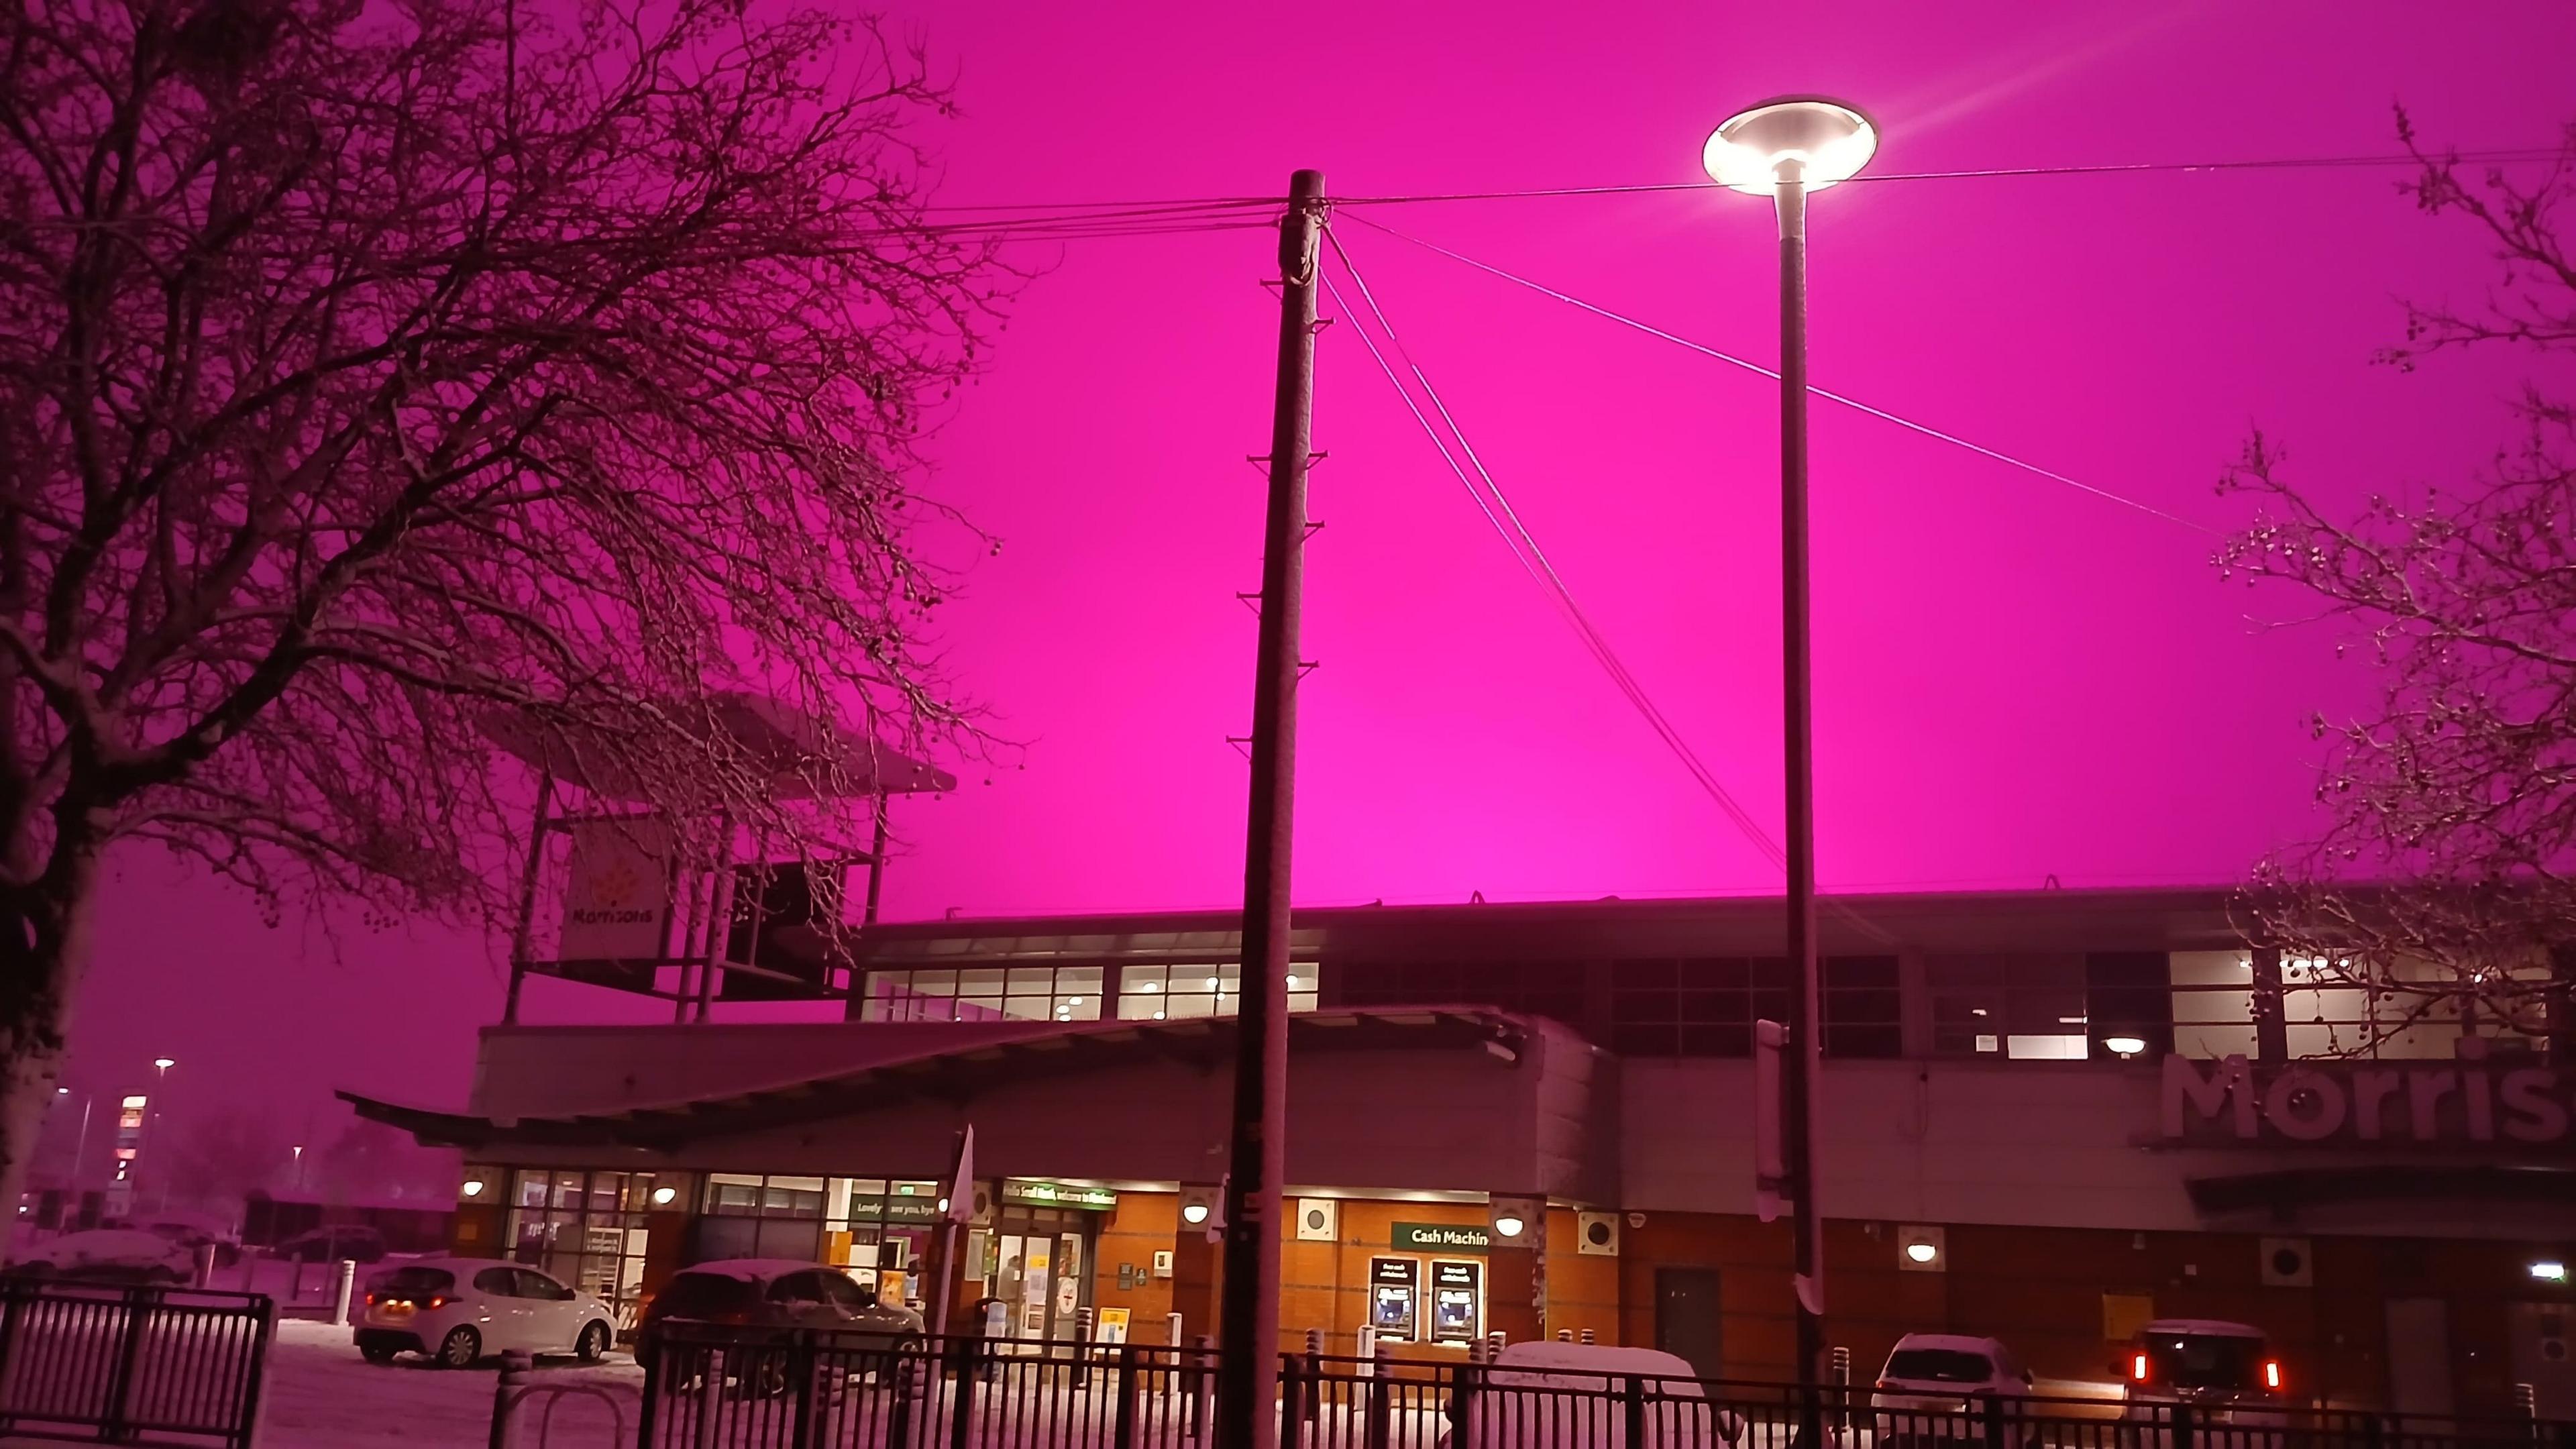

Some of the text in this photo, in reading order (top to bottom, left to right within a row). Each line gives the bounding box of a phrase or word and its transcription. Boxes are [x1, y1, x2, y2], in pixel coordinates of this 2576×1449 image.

[2161, 1034, 2576, 1141] Morris
[1411, 1229, 1489, 1246] Cash Machin
